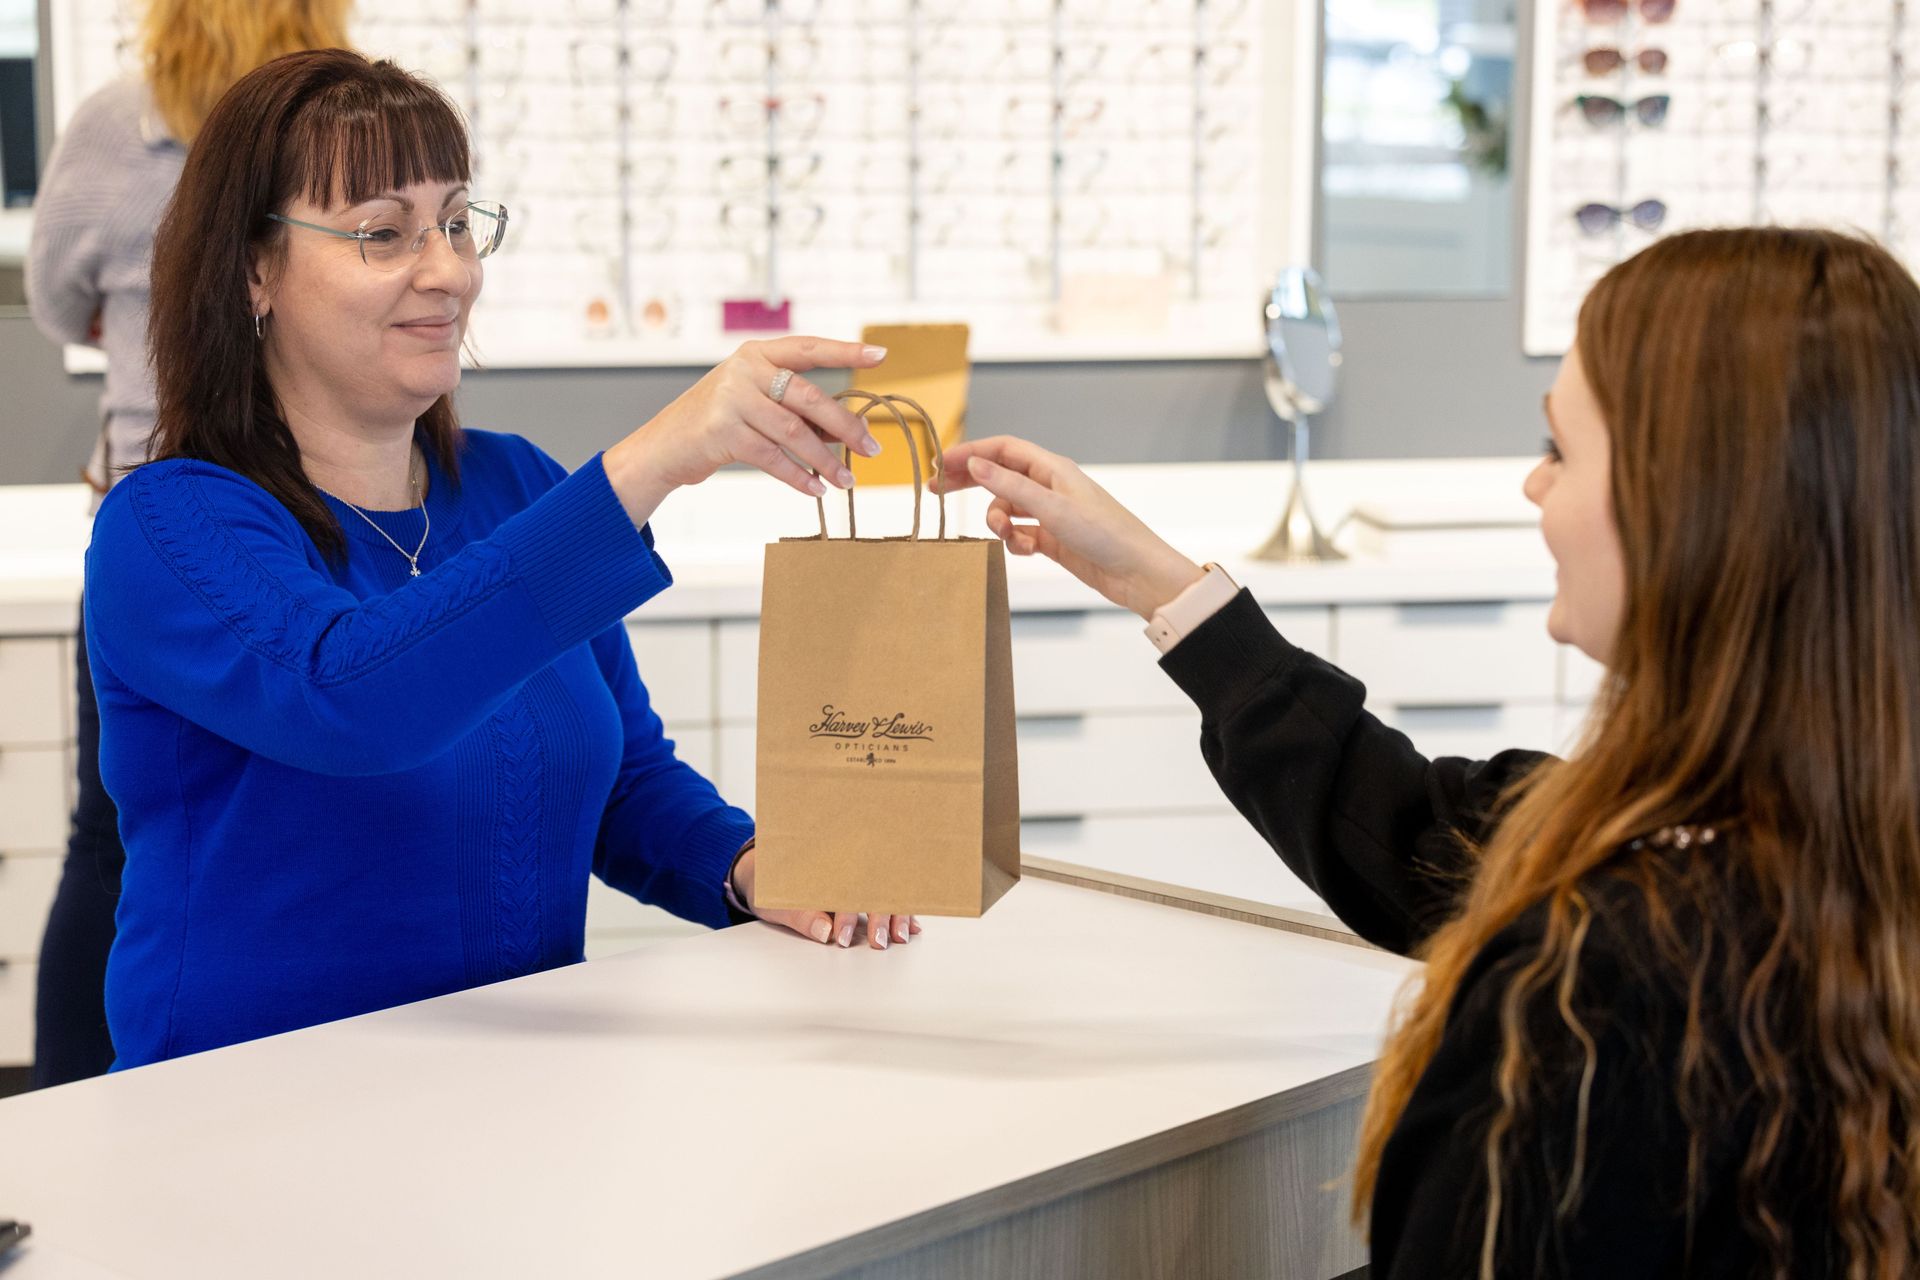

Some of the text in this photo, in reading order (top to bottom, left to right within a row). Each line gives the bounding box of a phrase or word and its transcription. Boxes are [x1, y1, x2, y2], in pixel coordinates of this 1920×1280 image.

[809, 704, 871, 739] Harvey
[872, 712, 935, 742] Lewis
[834, 742, 909, 752] OPTICIANS
